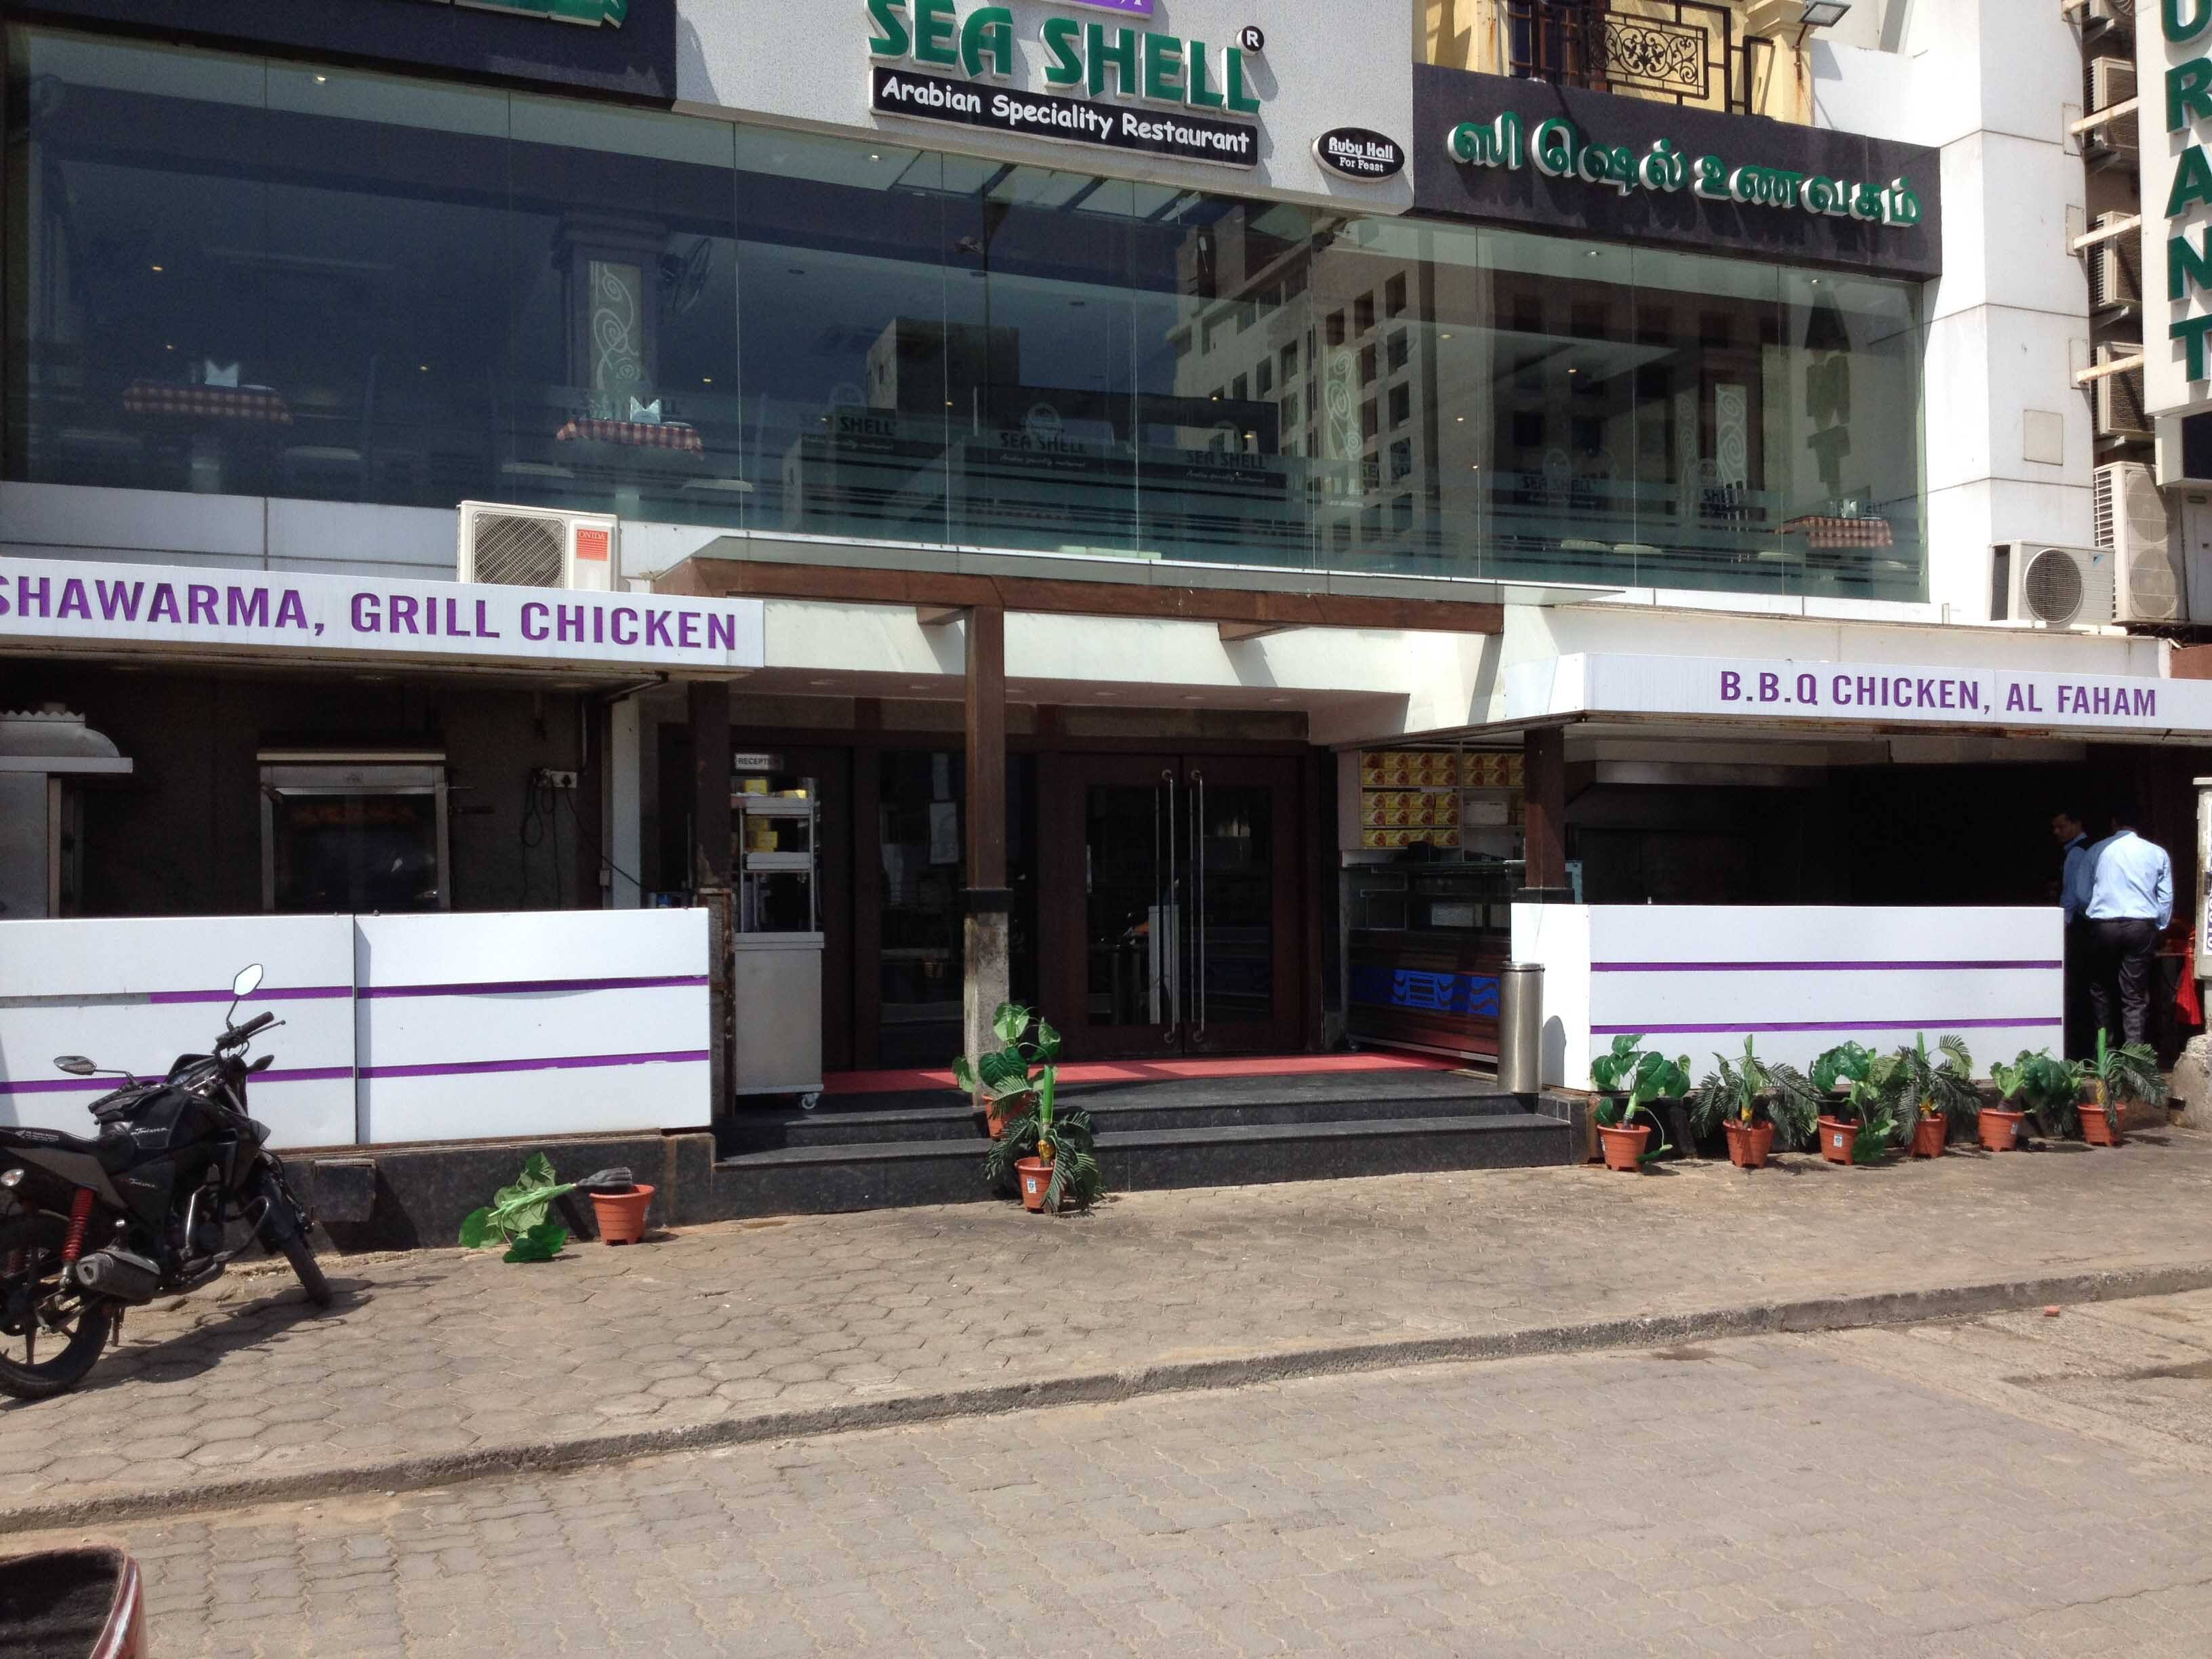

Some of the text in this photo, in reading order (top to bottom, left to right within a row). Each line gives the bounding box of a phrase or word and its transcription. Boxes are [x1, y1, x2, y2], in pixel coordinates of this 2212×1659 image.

[867, 0, 1014, 80] SEA
[1040, 16, 1261, 114] SHELL
[881, 76, 1250, 155] Arabian Speciality Restaurant
[1328, 137, 1394, 160] Ruby Hall
[1339, 157, 1384, 172] For Feast
[1694, 155, 1923, 226] உணவகம்
[1000, 432, 1030, 450] SEA
[578, 531, 607, 540] ONIDA
[350, 591, 500, 639] GRILL
[520, 601, 737, 651] CHICKEN
[1719, 670, 2156, 717] B.B.Q CHICKEN, AL FAHAM
